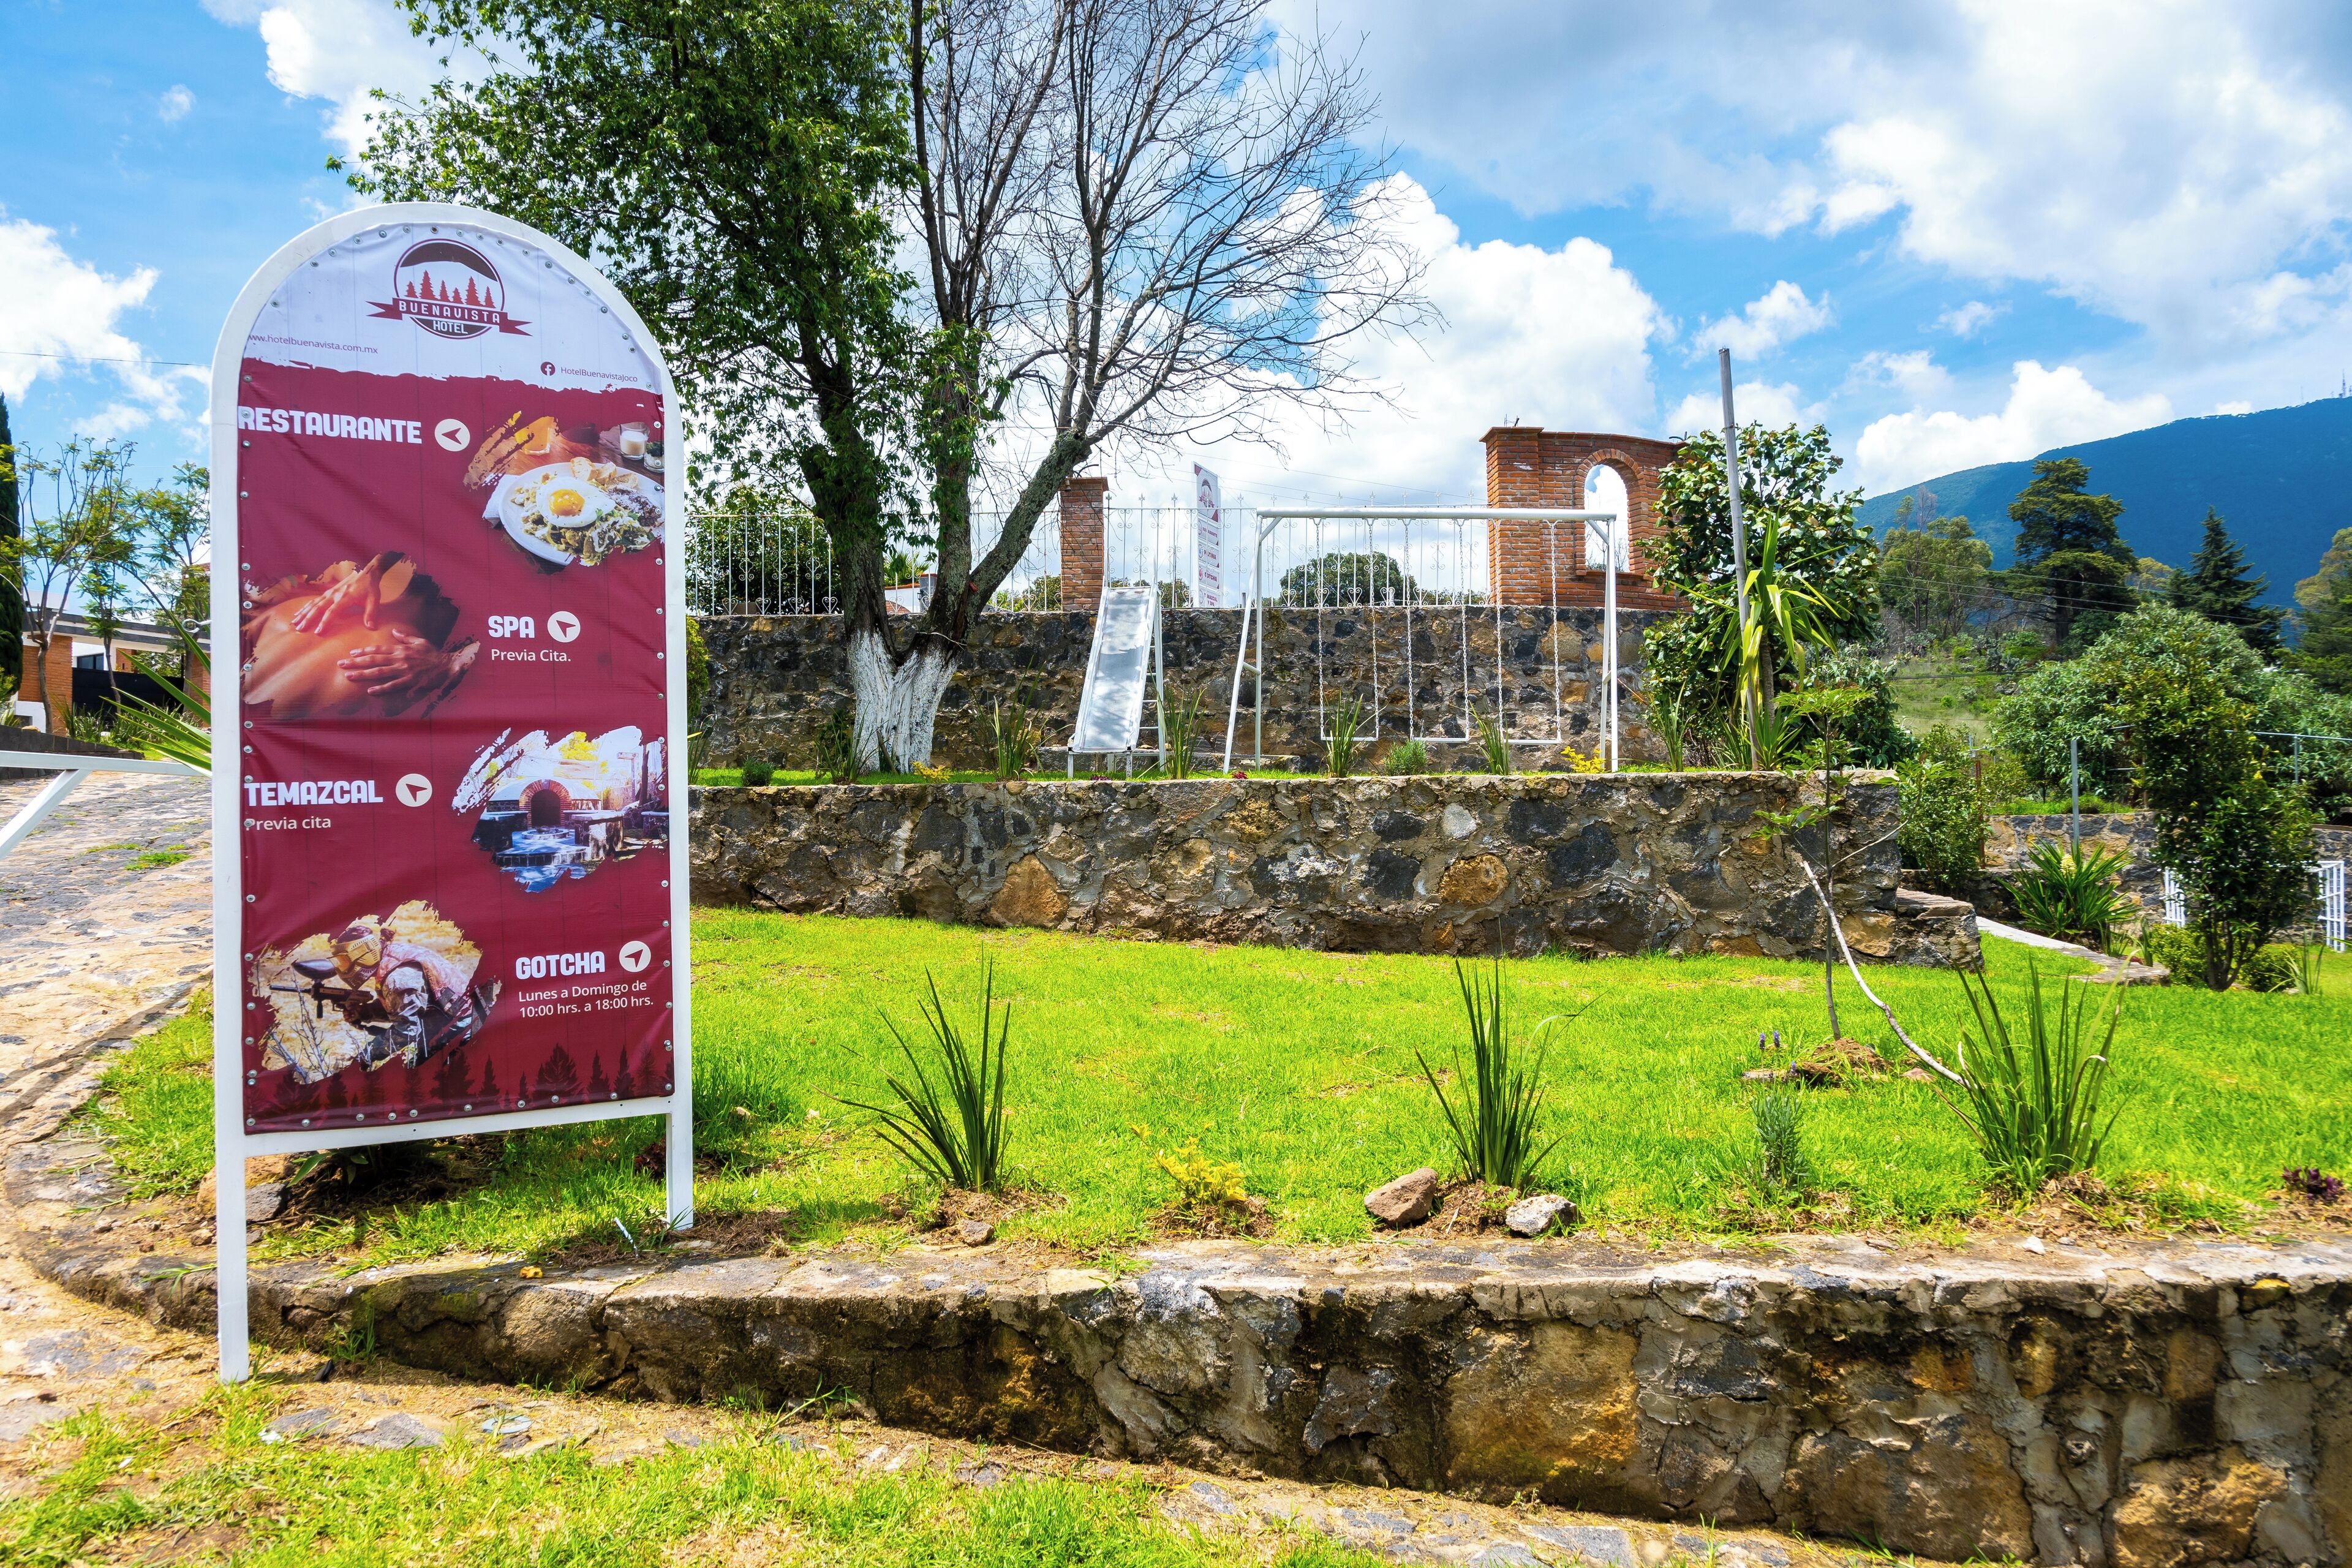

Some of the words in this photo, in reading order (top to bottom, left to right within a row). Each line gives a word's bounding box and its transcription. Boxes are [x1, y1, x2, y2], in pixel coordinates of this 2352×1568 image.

[399, 300, 500, 323] BUENAVISTA
[432, 320, 469, 335] HOTEL
[248, 334, 379, 354] ww.hotelbuenavista.com.mx
[560, 367, 638, 382] HotelBuenavistaJoco
[238, 405, 422, 444] RESTAURANTE
[1202, 527, 1218, 538] RESAURANTE
[1204, 592, 1218, 601] TMAZCAL
[488, 615, 535, 638] SPA
[491, 649, 536, 661] Previa
[540, 649, 571, 662] Cita.
[244, 780, 384, 807] TEMAZCAL
[302, 816, 331, 829] cita
[515, 951, 606, 980] GOTCHA
[518, 990, 558, 1002] Lunes
[560, 989, 568, 998] a
[572, 983, 628, 996] Domingo
[631, 980, 647, 991] de
[519, 1005, 554, 1018] 10:00
[557, 1003, 581, 1014] hrs.
[584, 1003, 592, 1012] a
[595, 997, 628, 1011] 18:00
[631, 995, 654, 1007] hrs.
